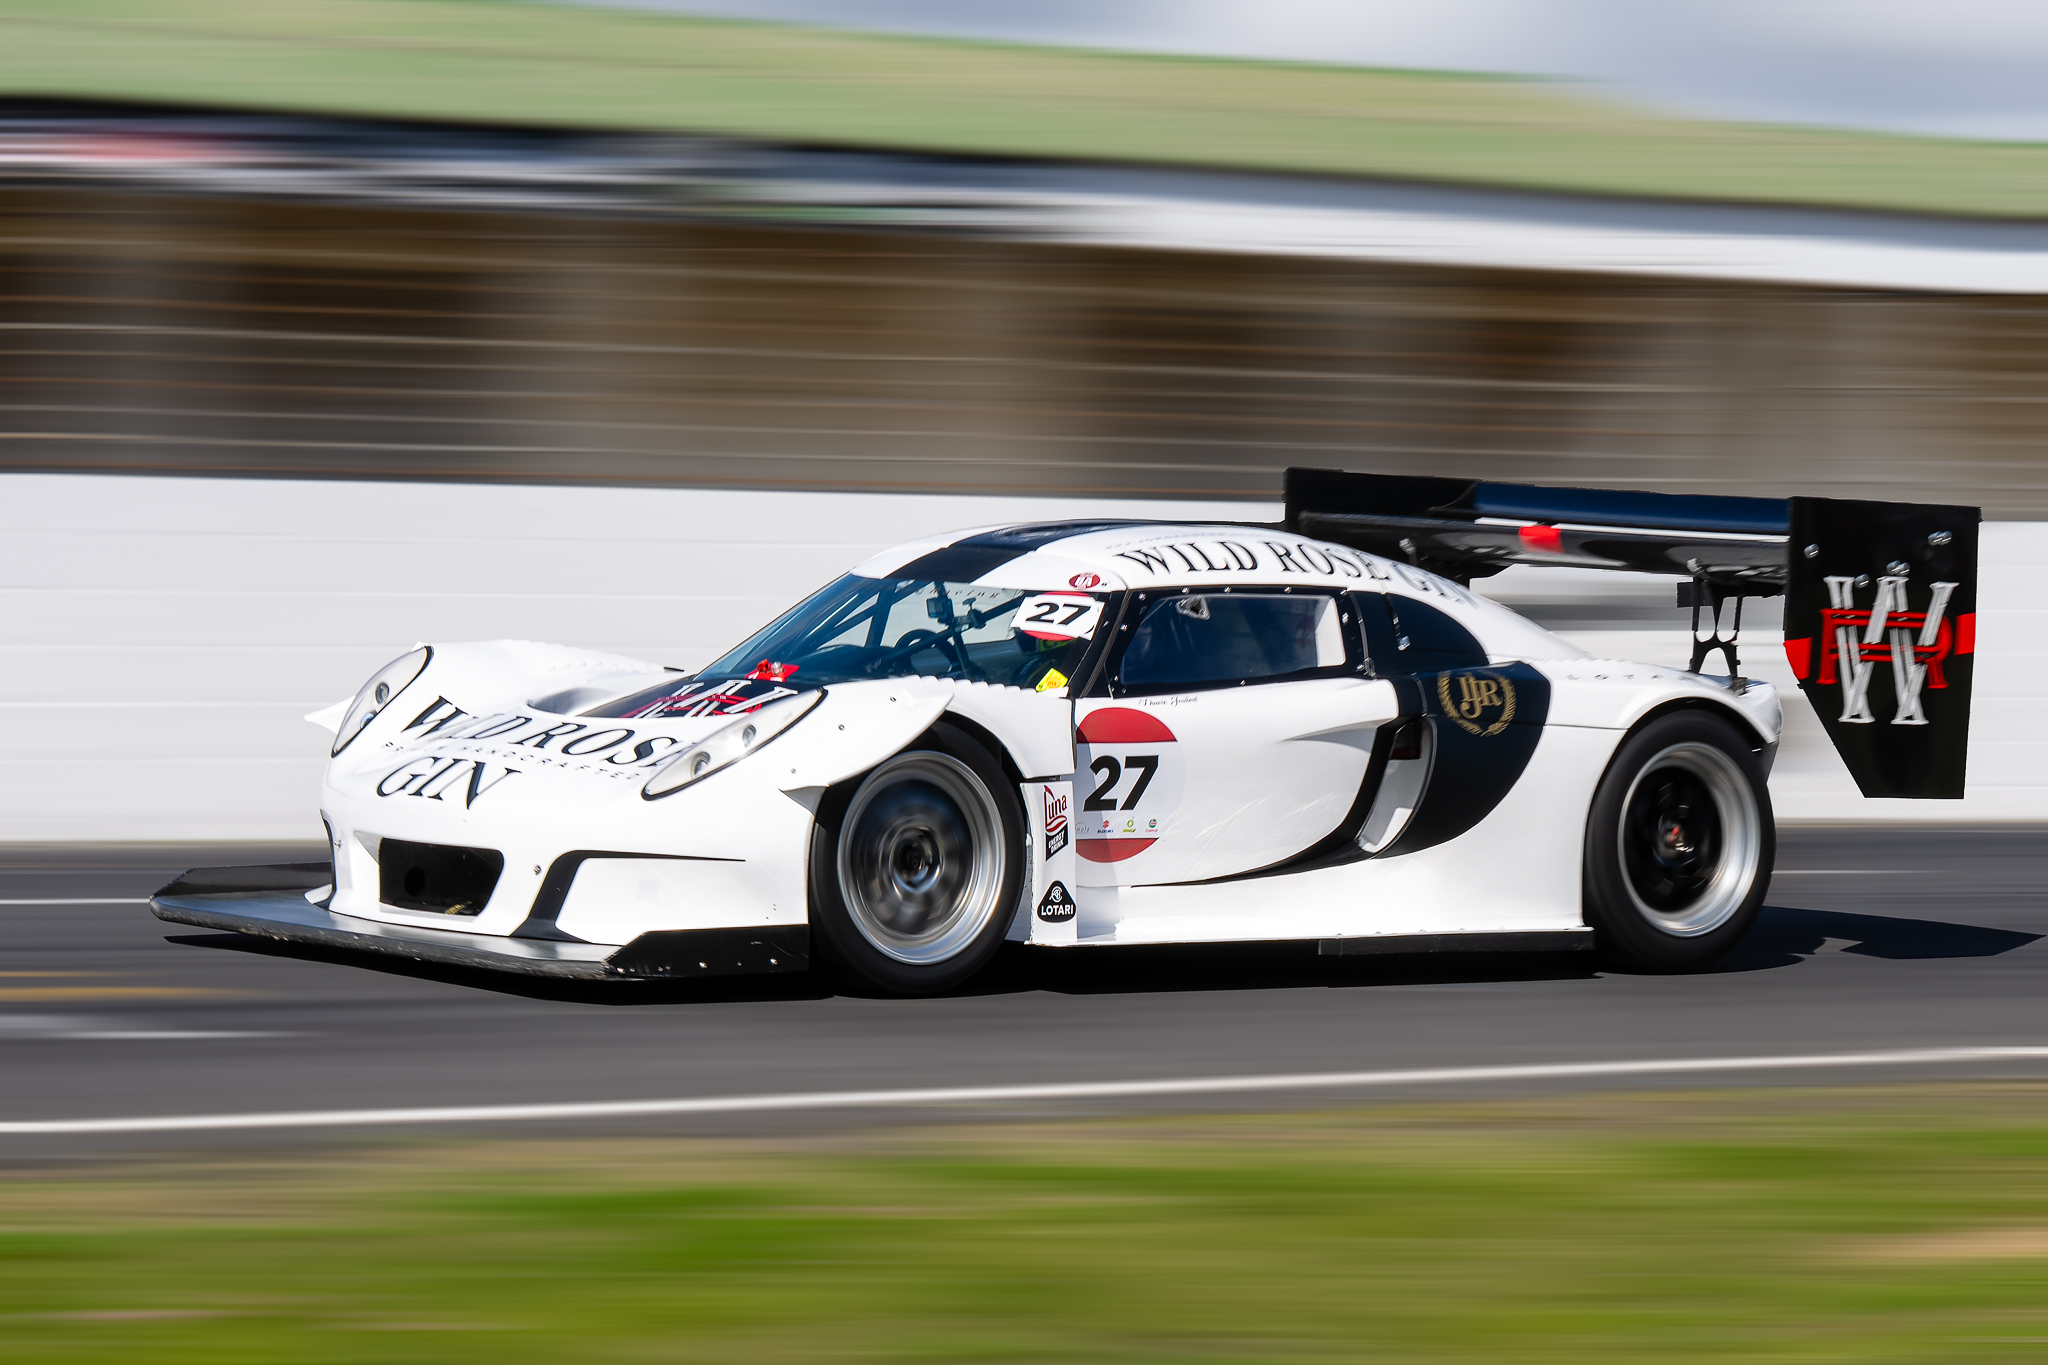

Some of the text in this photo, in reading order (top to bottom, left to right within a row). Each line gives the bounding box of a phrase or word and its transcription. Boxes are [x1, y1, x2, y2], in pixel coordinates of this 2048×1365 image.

[1112, 540, 1259, 576] WILD
[1258, 540, 1393, 582] ROSE
[1025, 602, 1092, 626] 27
[376, 756, 523, 810] GIN
[1083, 754, 1159, 812] 27
[1044, 785, 1067, 831] Luna
[1048, 829, 1065, 849] ENERGY
[1050, 840, 1064, 854] DRINK
[1041, 904, 1074, 916] LOTARI
